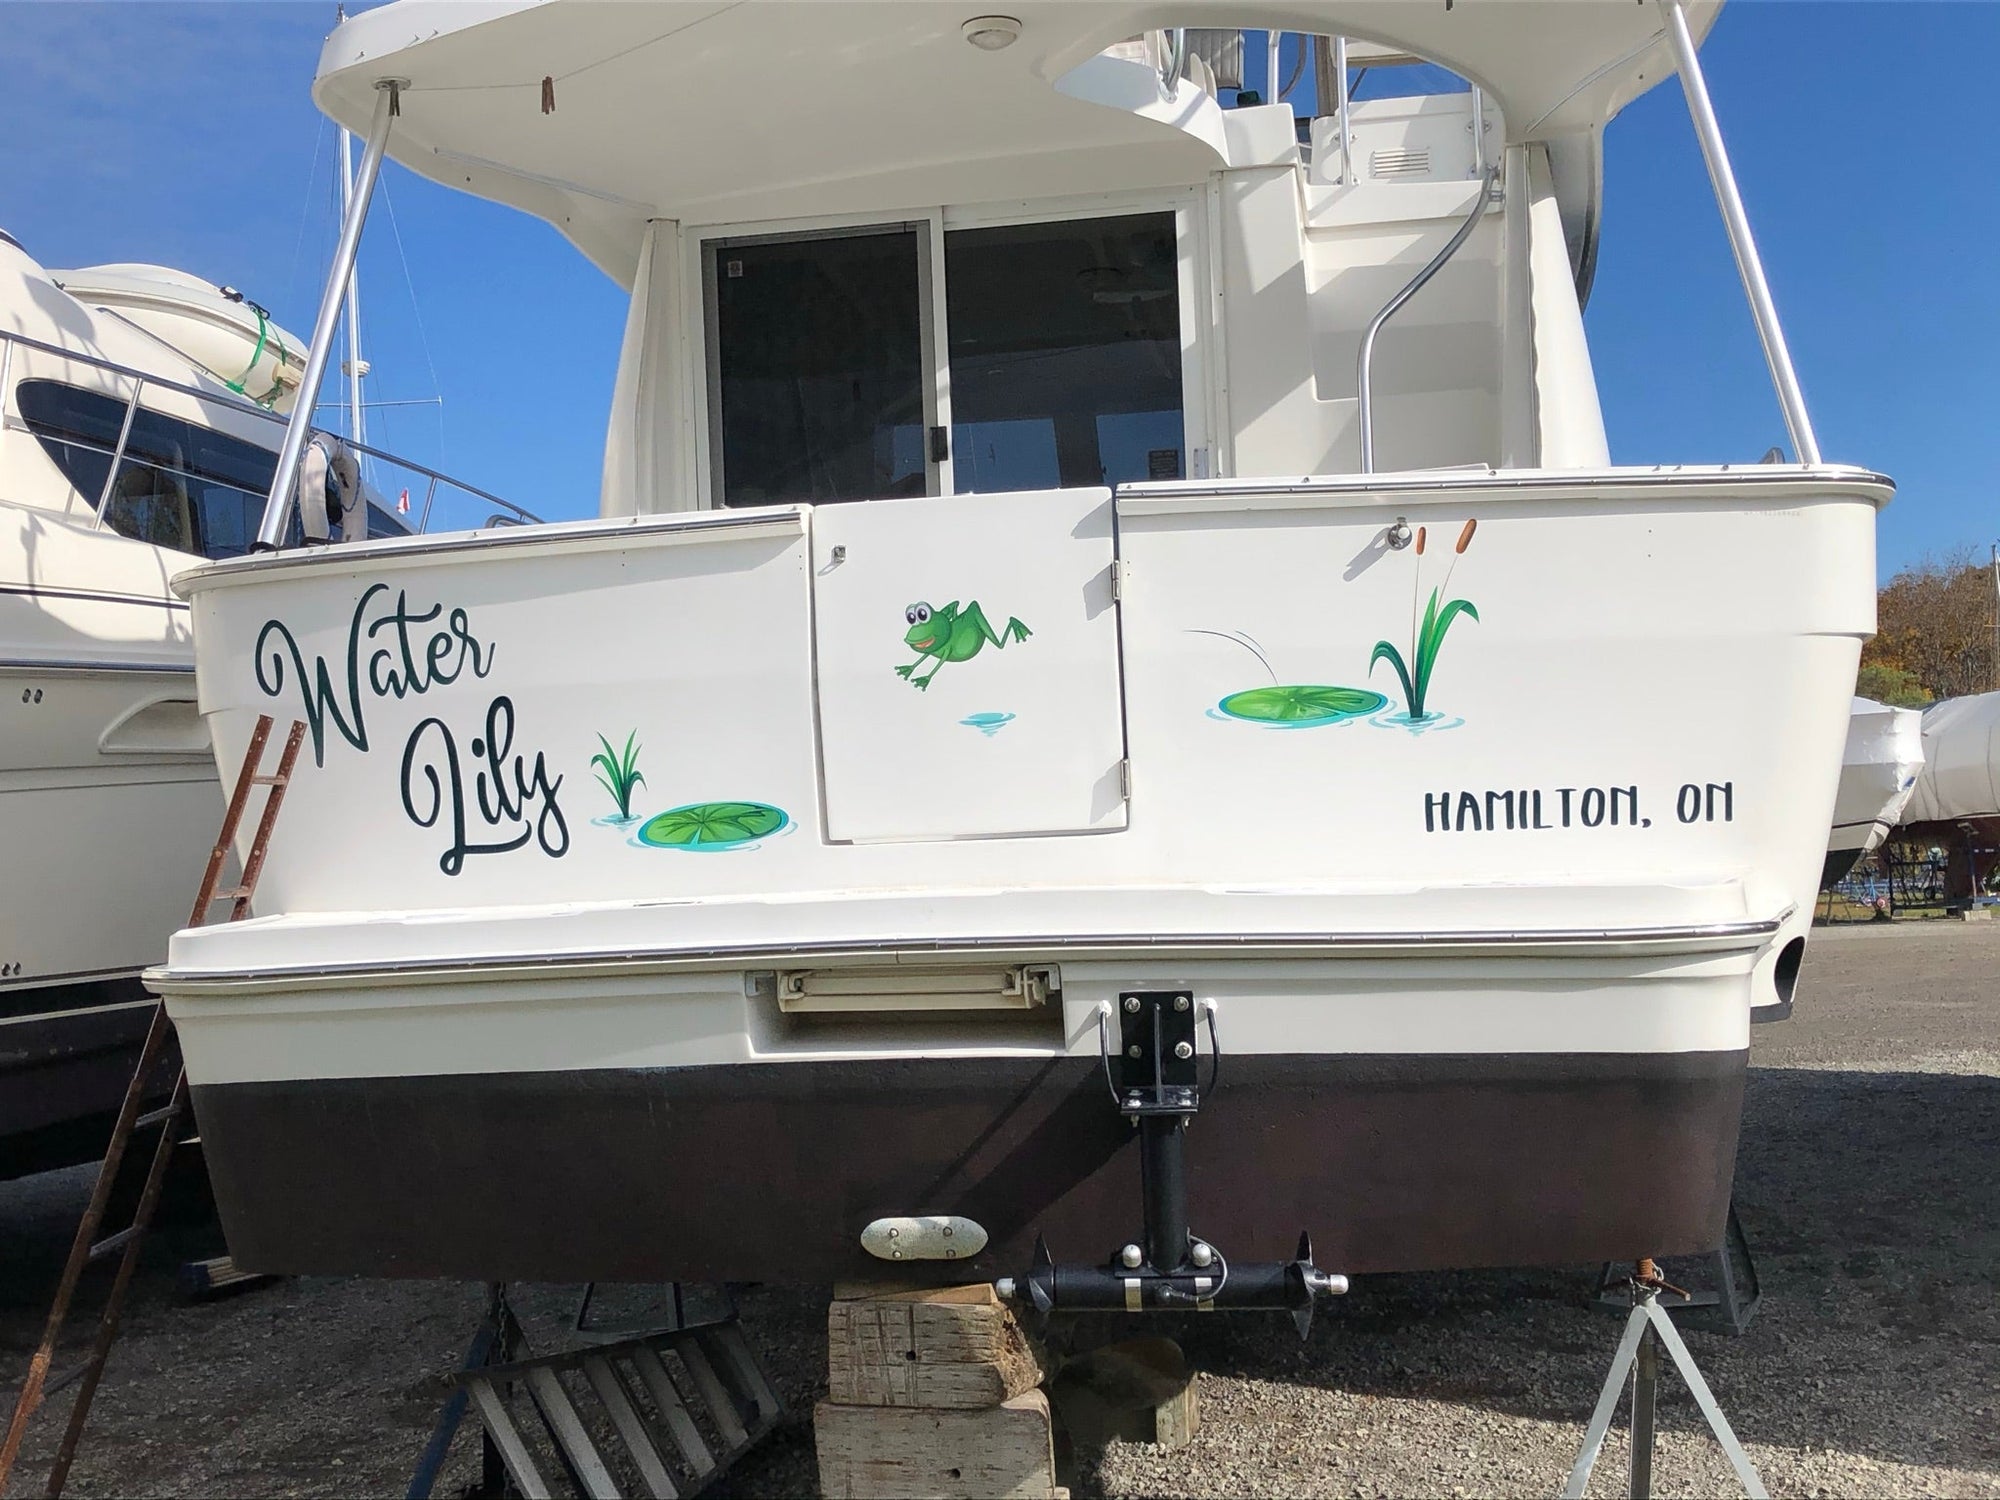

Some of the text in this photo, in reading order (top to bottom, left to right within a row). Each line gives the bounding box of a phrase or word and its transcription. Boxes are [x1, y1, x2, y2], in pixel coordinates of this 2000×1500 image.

[255, 583, 496, 768] Water
[400, 696, 570, 876] Lily
[1425, 781, 1733, 832] HAMILTON, ON
